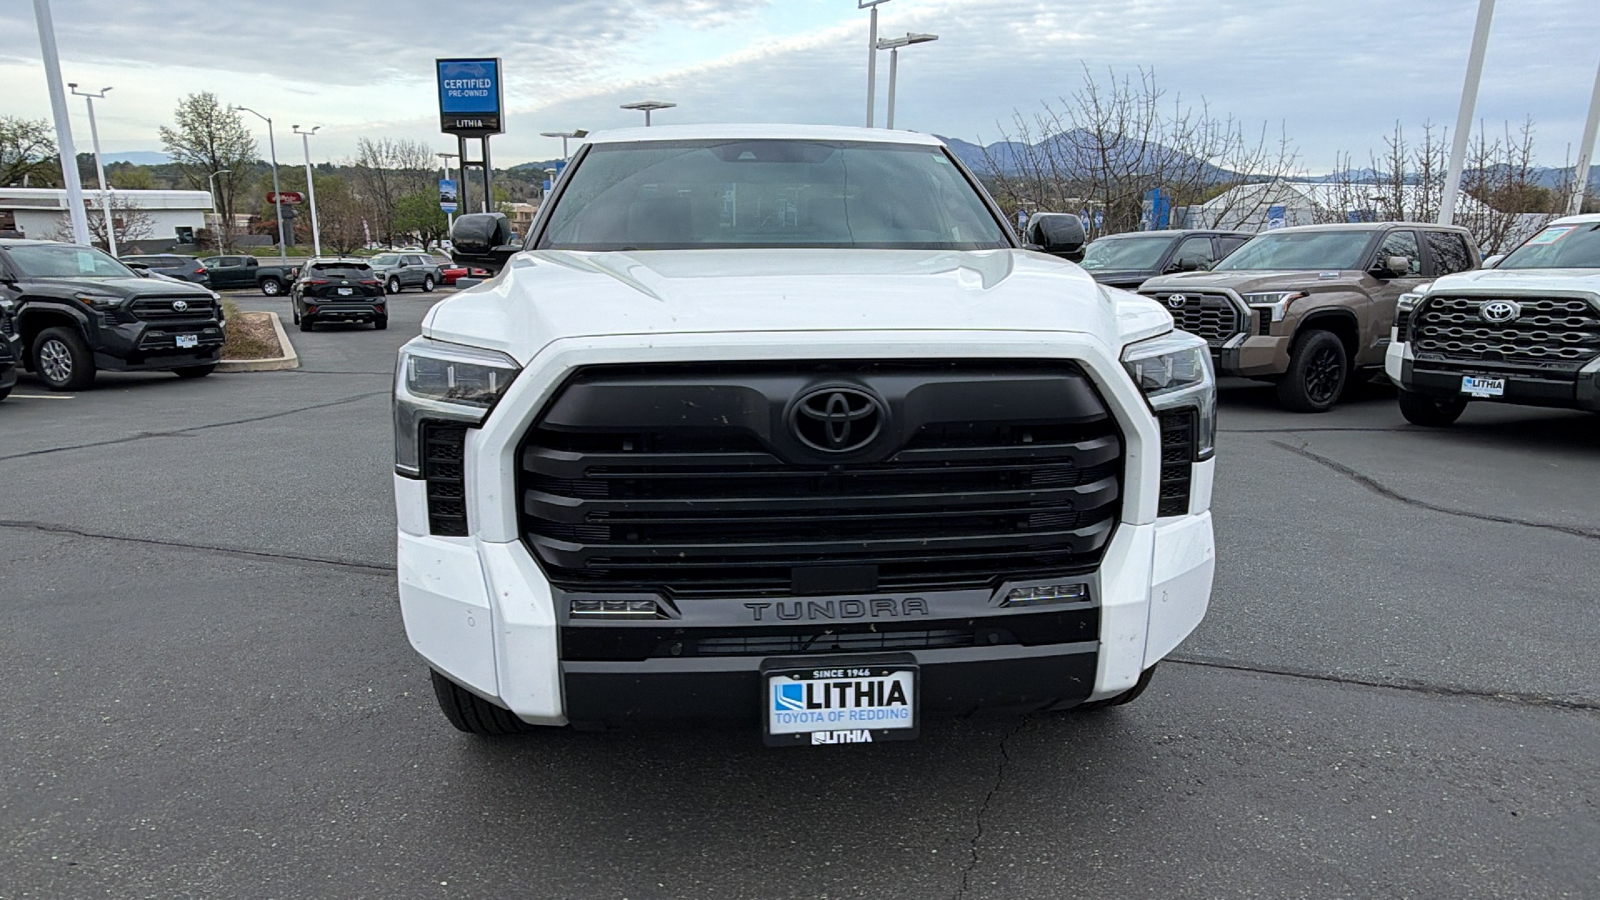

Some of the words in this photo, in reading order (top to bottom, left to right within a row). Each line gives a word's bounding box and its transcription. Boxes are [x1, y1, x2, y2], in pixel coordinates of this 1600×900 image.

[444, 79, 491, 88] CERTIFIED
[456, 119, 483, 128] LITHIA
[1472, 380, 1502, 389] LITHIA
[744, 597, 929, 621] TUNDRA
[813, 669, 844, 679] SINCE
[847, 668, 871, 677] 1946
[806, 680, 908, 710] LITHIA
[774, 712, 825, 723] TOYOTA
[828, 710, 845, 722] OF
[849, 708, 909, 721] REDDING
[825, 729, 873, 744] LITHIA
